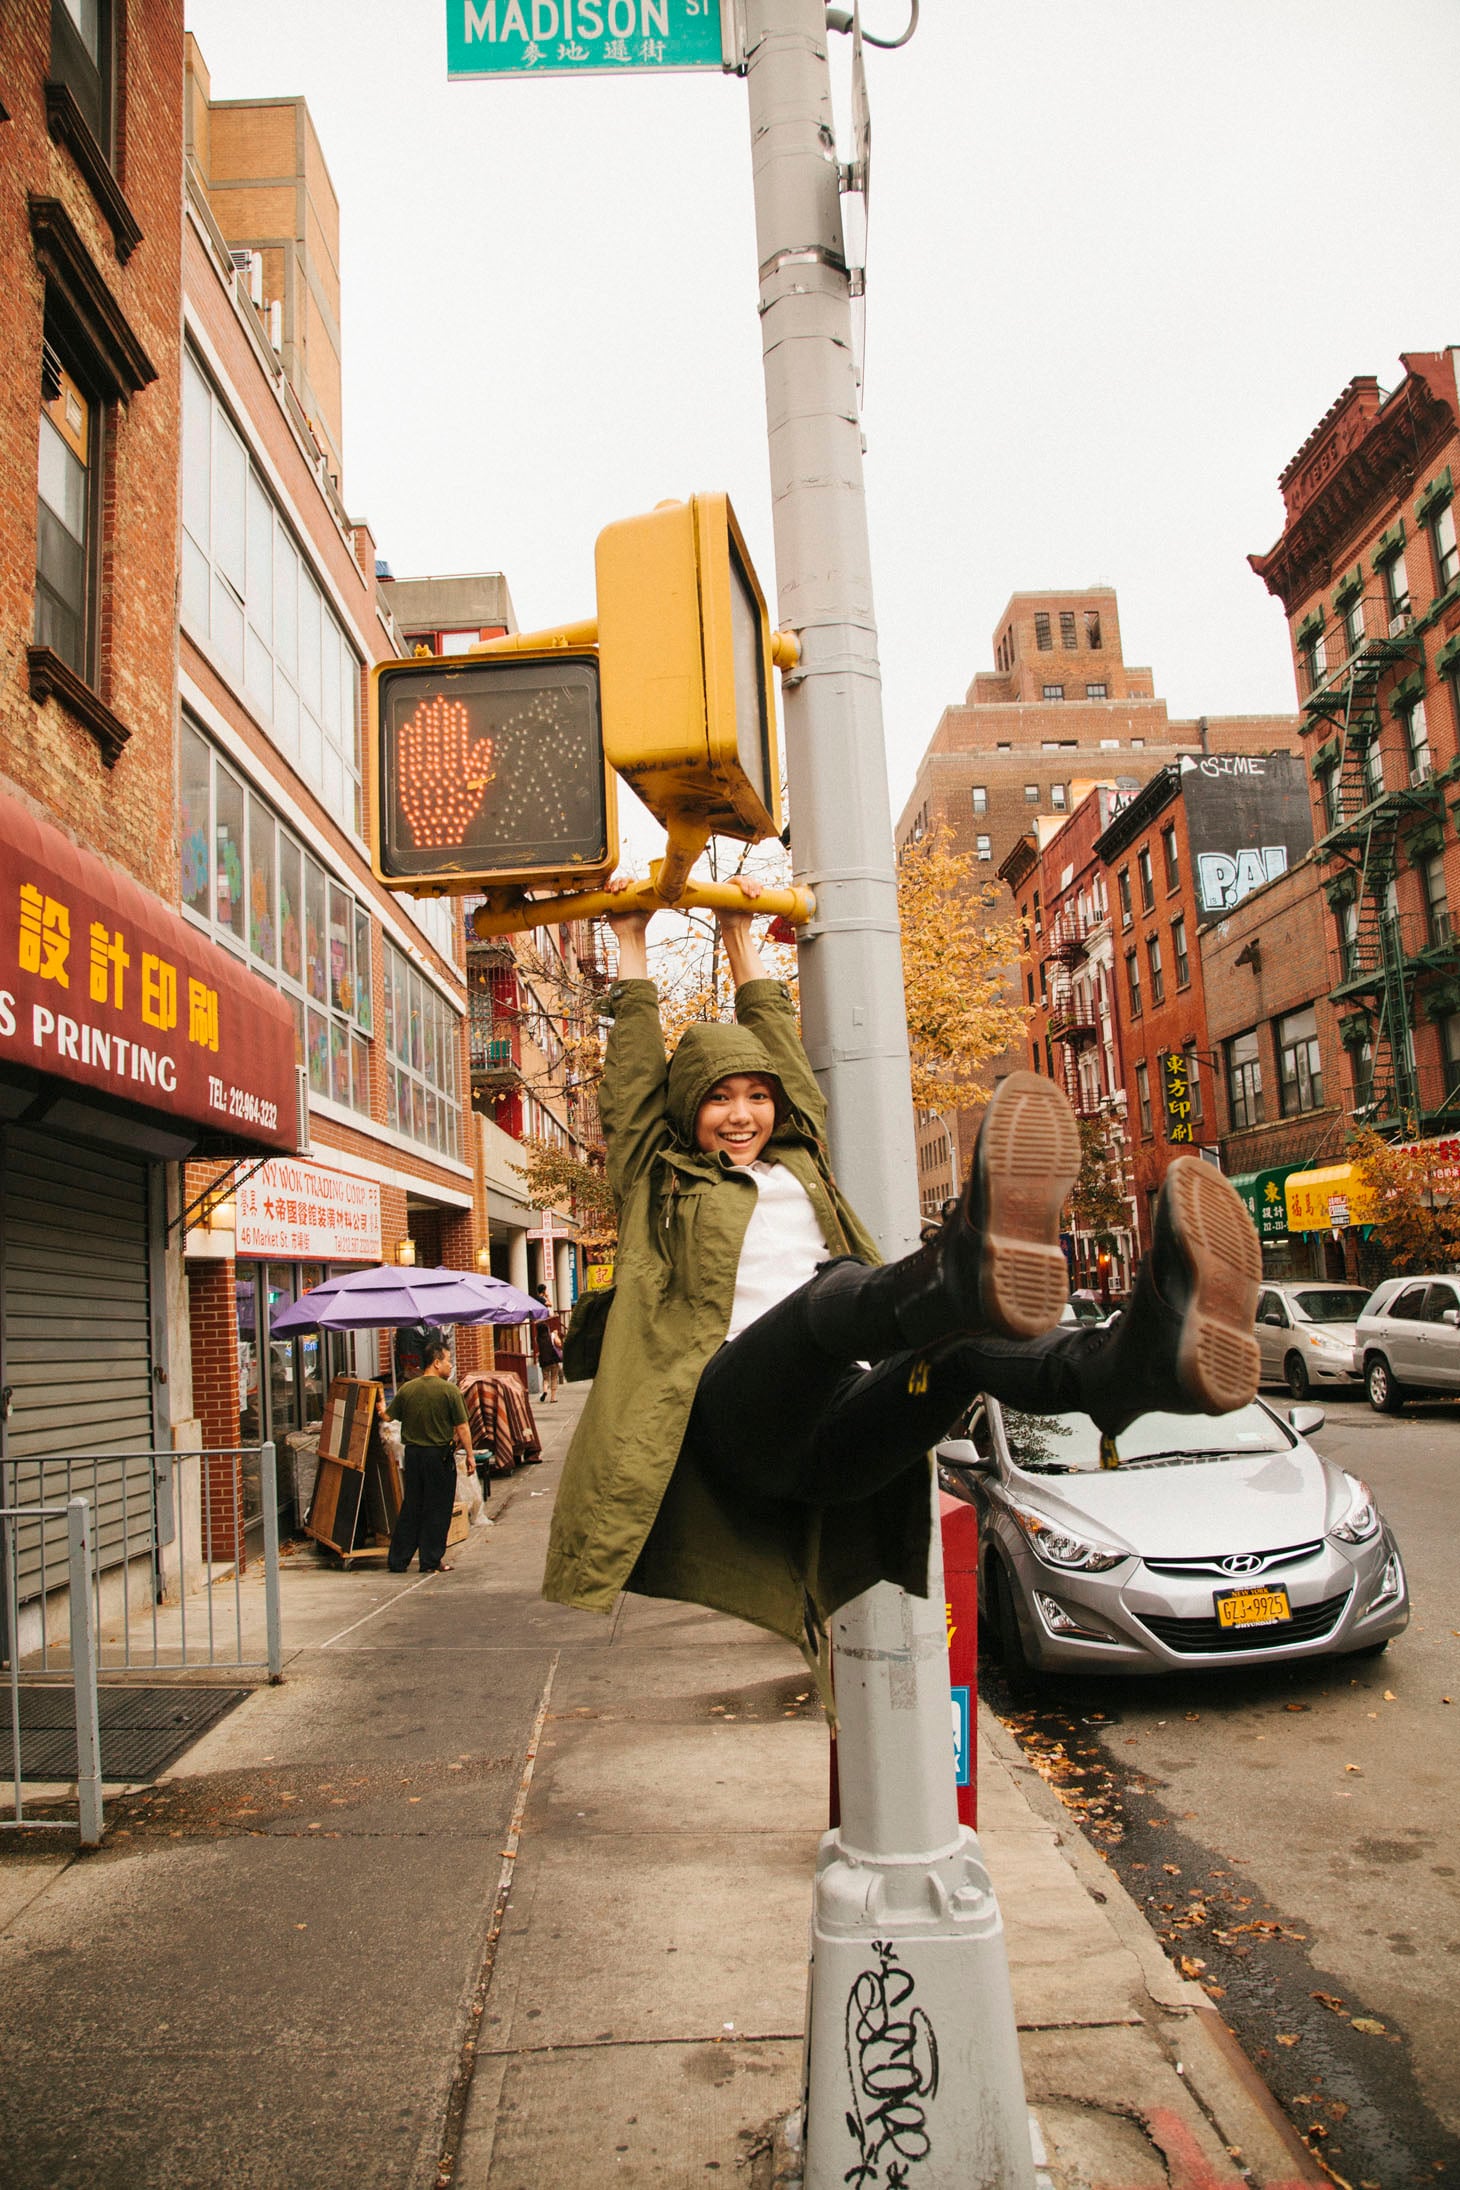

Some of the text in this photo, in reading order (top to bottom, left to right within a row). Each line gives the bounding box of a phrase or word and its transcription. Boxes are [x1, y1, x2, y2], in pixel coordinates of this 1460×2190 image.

[464, 0, 670, 43] MADISON
[19, 883, 219, 1053] 設計印刷
[33, 1004, 177, 1092] PRINTING
[208, 1075, 227, 1112] TEL:
[1167, 1054, 1194, 1142] 東方印刷
[262, 1162, 277, 1188] NY
[279, 1164, 303, 1192] WOK
[304, 1172, 343, 1202] TRADING
[241, 1227, 251, 1244] 46
[253, 1227, 279, 1247] Market
[595, 1267, 612, 1284] 記
[1231, 1589, 1248, 1598] NEW
[1251, 1587, 1269, 1596] YORK
